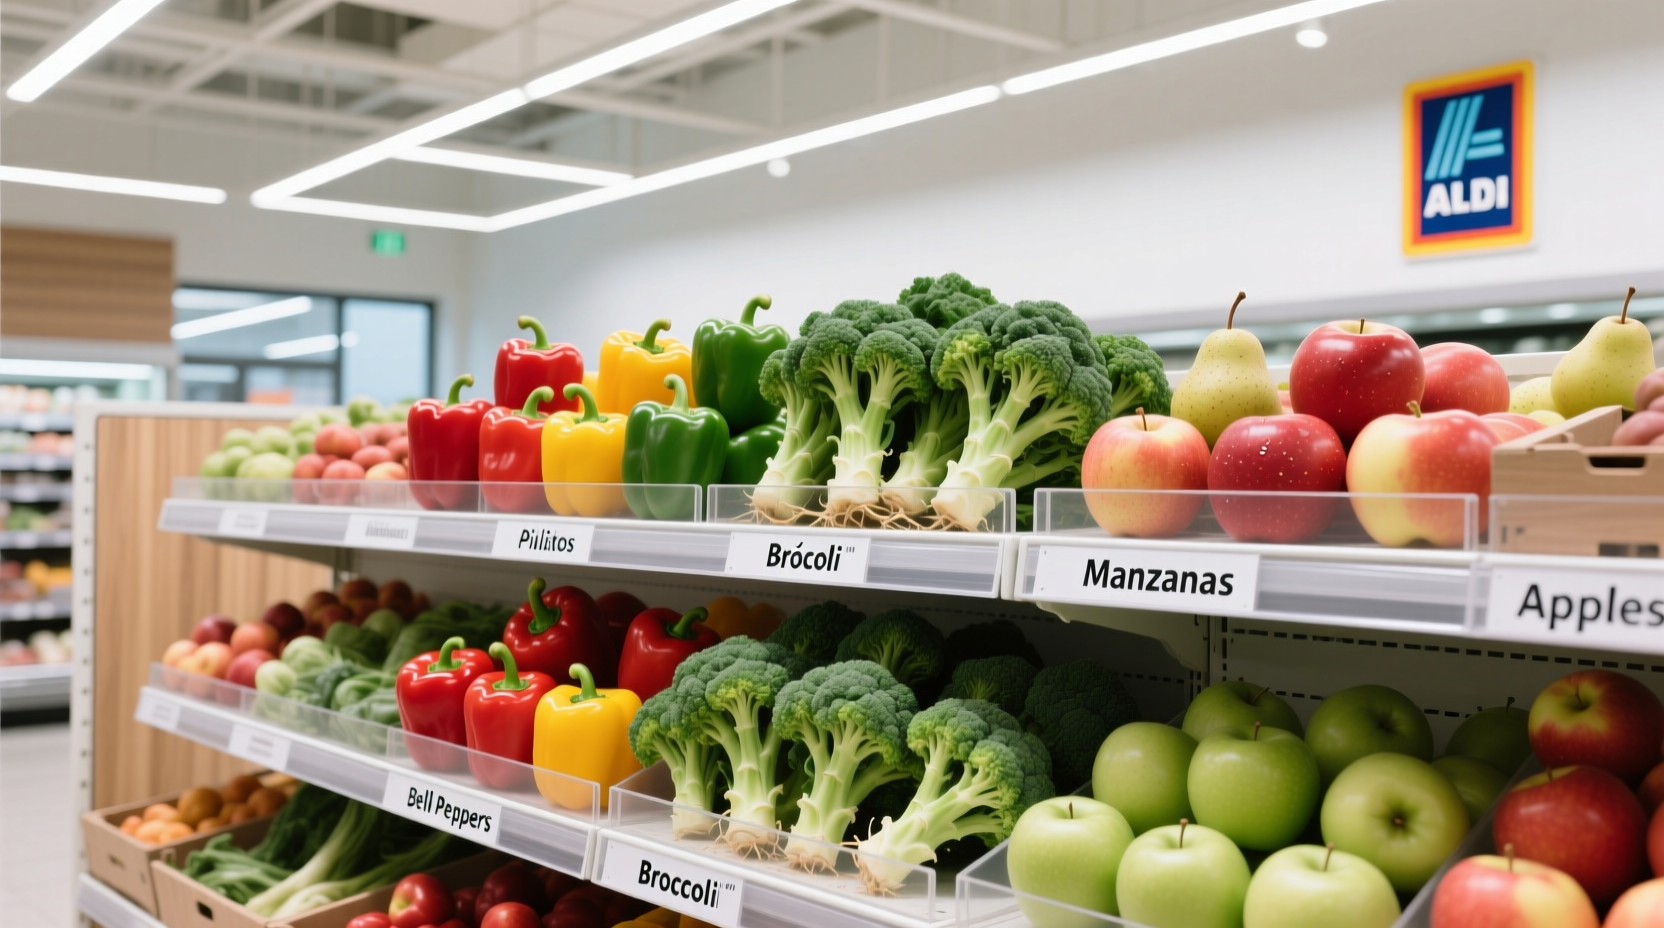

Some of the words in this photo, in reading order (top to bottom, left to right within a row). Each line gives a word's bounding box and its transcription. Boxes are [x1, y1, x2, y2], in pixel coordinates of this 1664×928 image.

[1422, 174, 1510, 219] ALDI
[766, 541, 843, 572] Brócoli
[1082, 558, 1235, 596] Manzanas
[1517, 583, 1664, 632] Apples
[407, 786, 434, 813] Bell
[435, 795, 492, 833] Peppers
